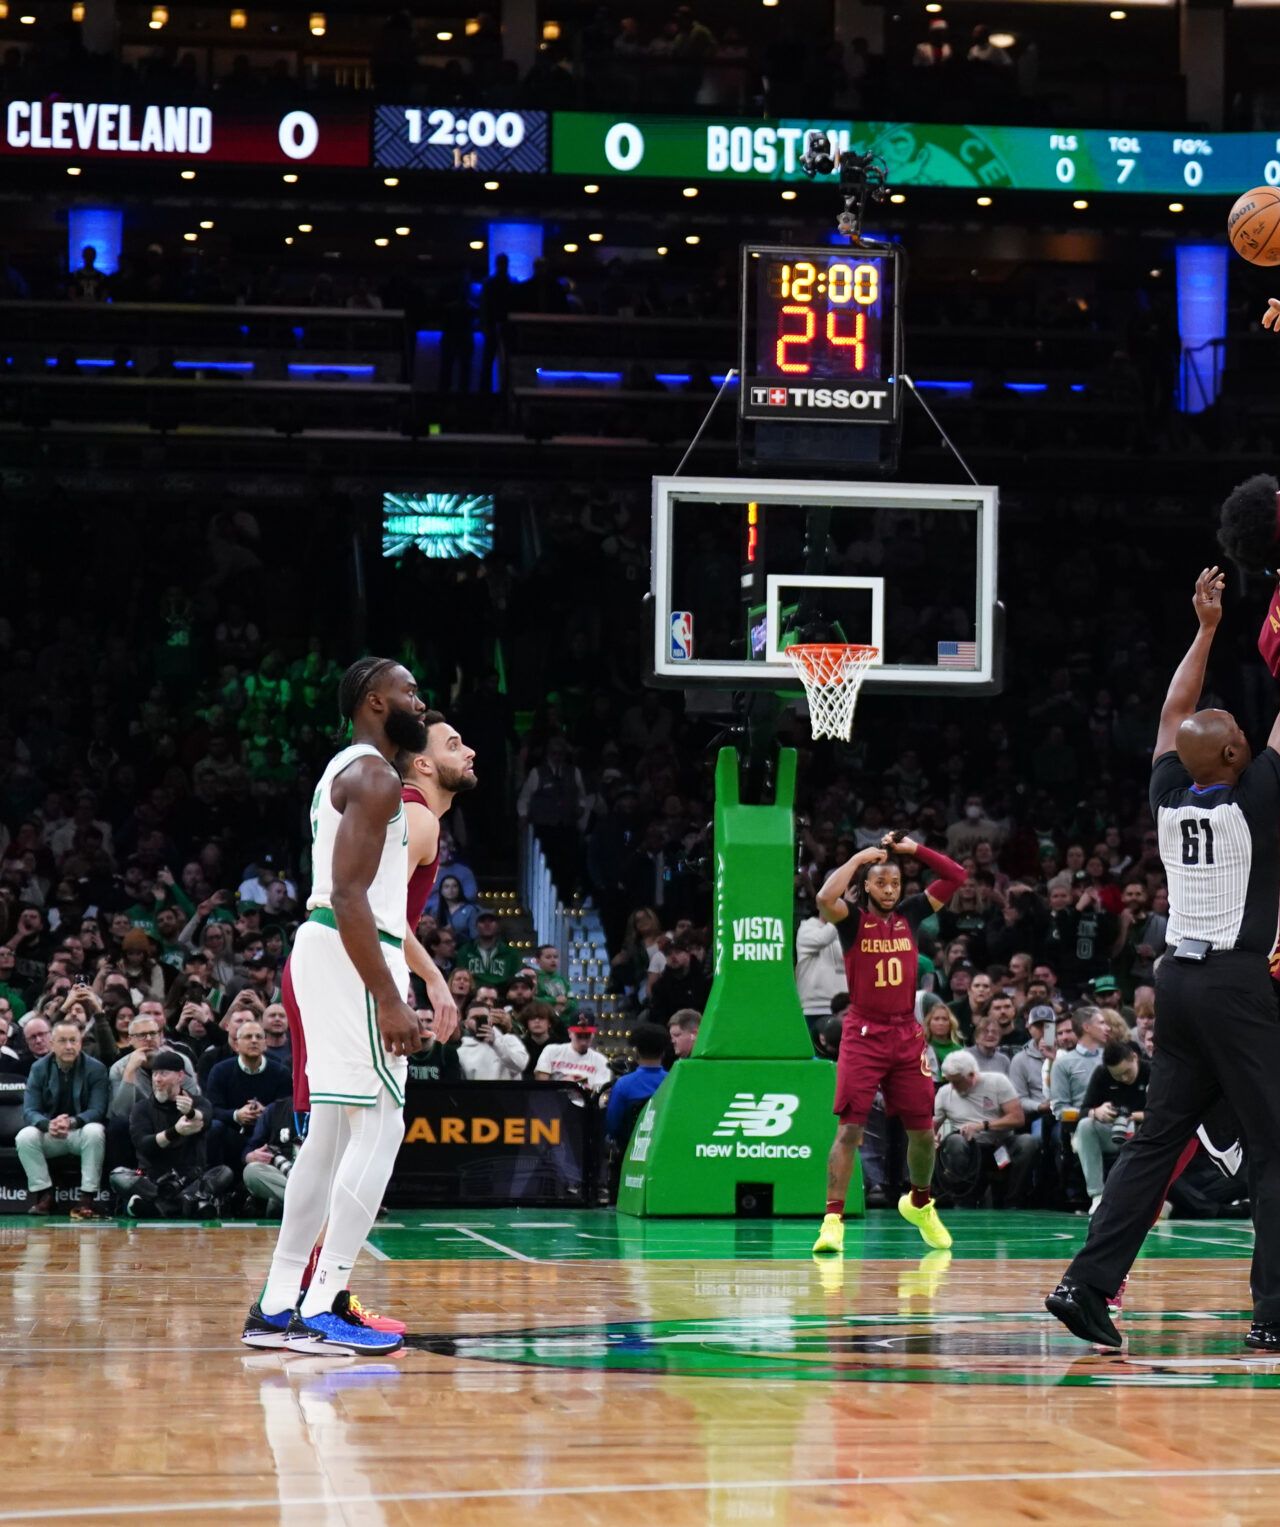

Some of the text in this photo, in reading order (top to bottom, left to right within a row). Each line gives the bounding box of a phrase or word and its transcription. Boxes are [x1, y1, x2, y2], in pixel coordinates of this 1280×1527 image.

[6, 100, 212, 153] CLEVELAND
[278, 111, 319, 160] 0
[404, 108, 525, 148] 12:00
[452, 148, 478, 168] 1st
[604, 121, 645, 172] 0
[1050, 134, 1078, 151] FLS
[1108, 136, 1142, 153] TOL
[1172, 138, 1213, 156] FG%
[1055, 157, 1075, 184] 0
[1116, 158, 1136, 185] 7
[1183, 161, 1203, 187] 0
[781, 262, 878, 305] 12:00
[776, 305, 866, 374] 24
[788, 387, 888, 410] TISSOT
[1180, 818, 1214, 865] 61
[732, 916, 784, 943] VISTA
[732, 943, 785, 961] PRINT
[860, 937, 912, 953] CLEVELAND
[468, 957, 505, 977] CELICS
[874, 957, 903, 988] 10
[404, 1116, 561, 1145] ARDEN
[695, 1141, 812, 1159] new balance
[0, 1186, 28, 1200] lue
[55, 1186, 110, 1202] jetBe
